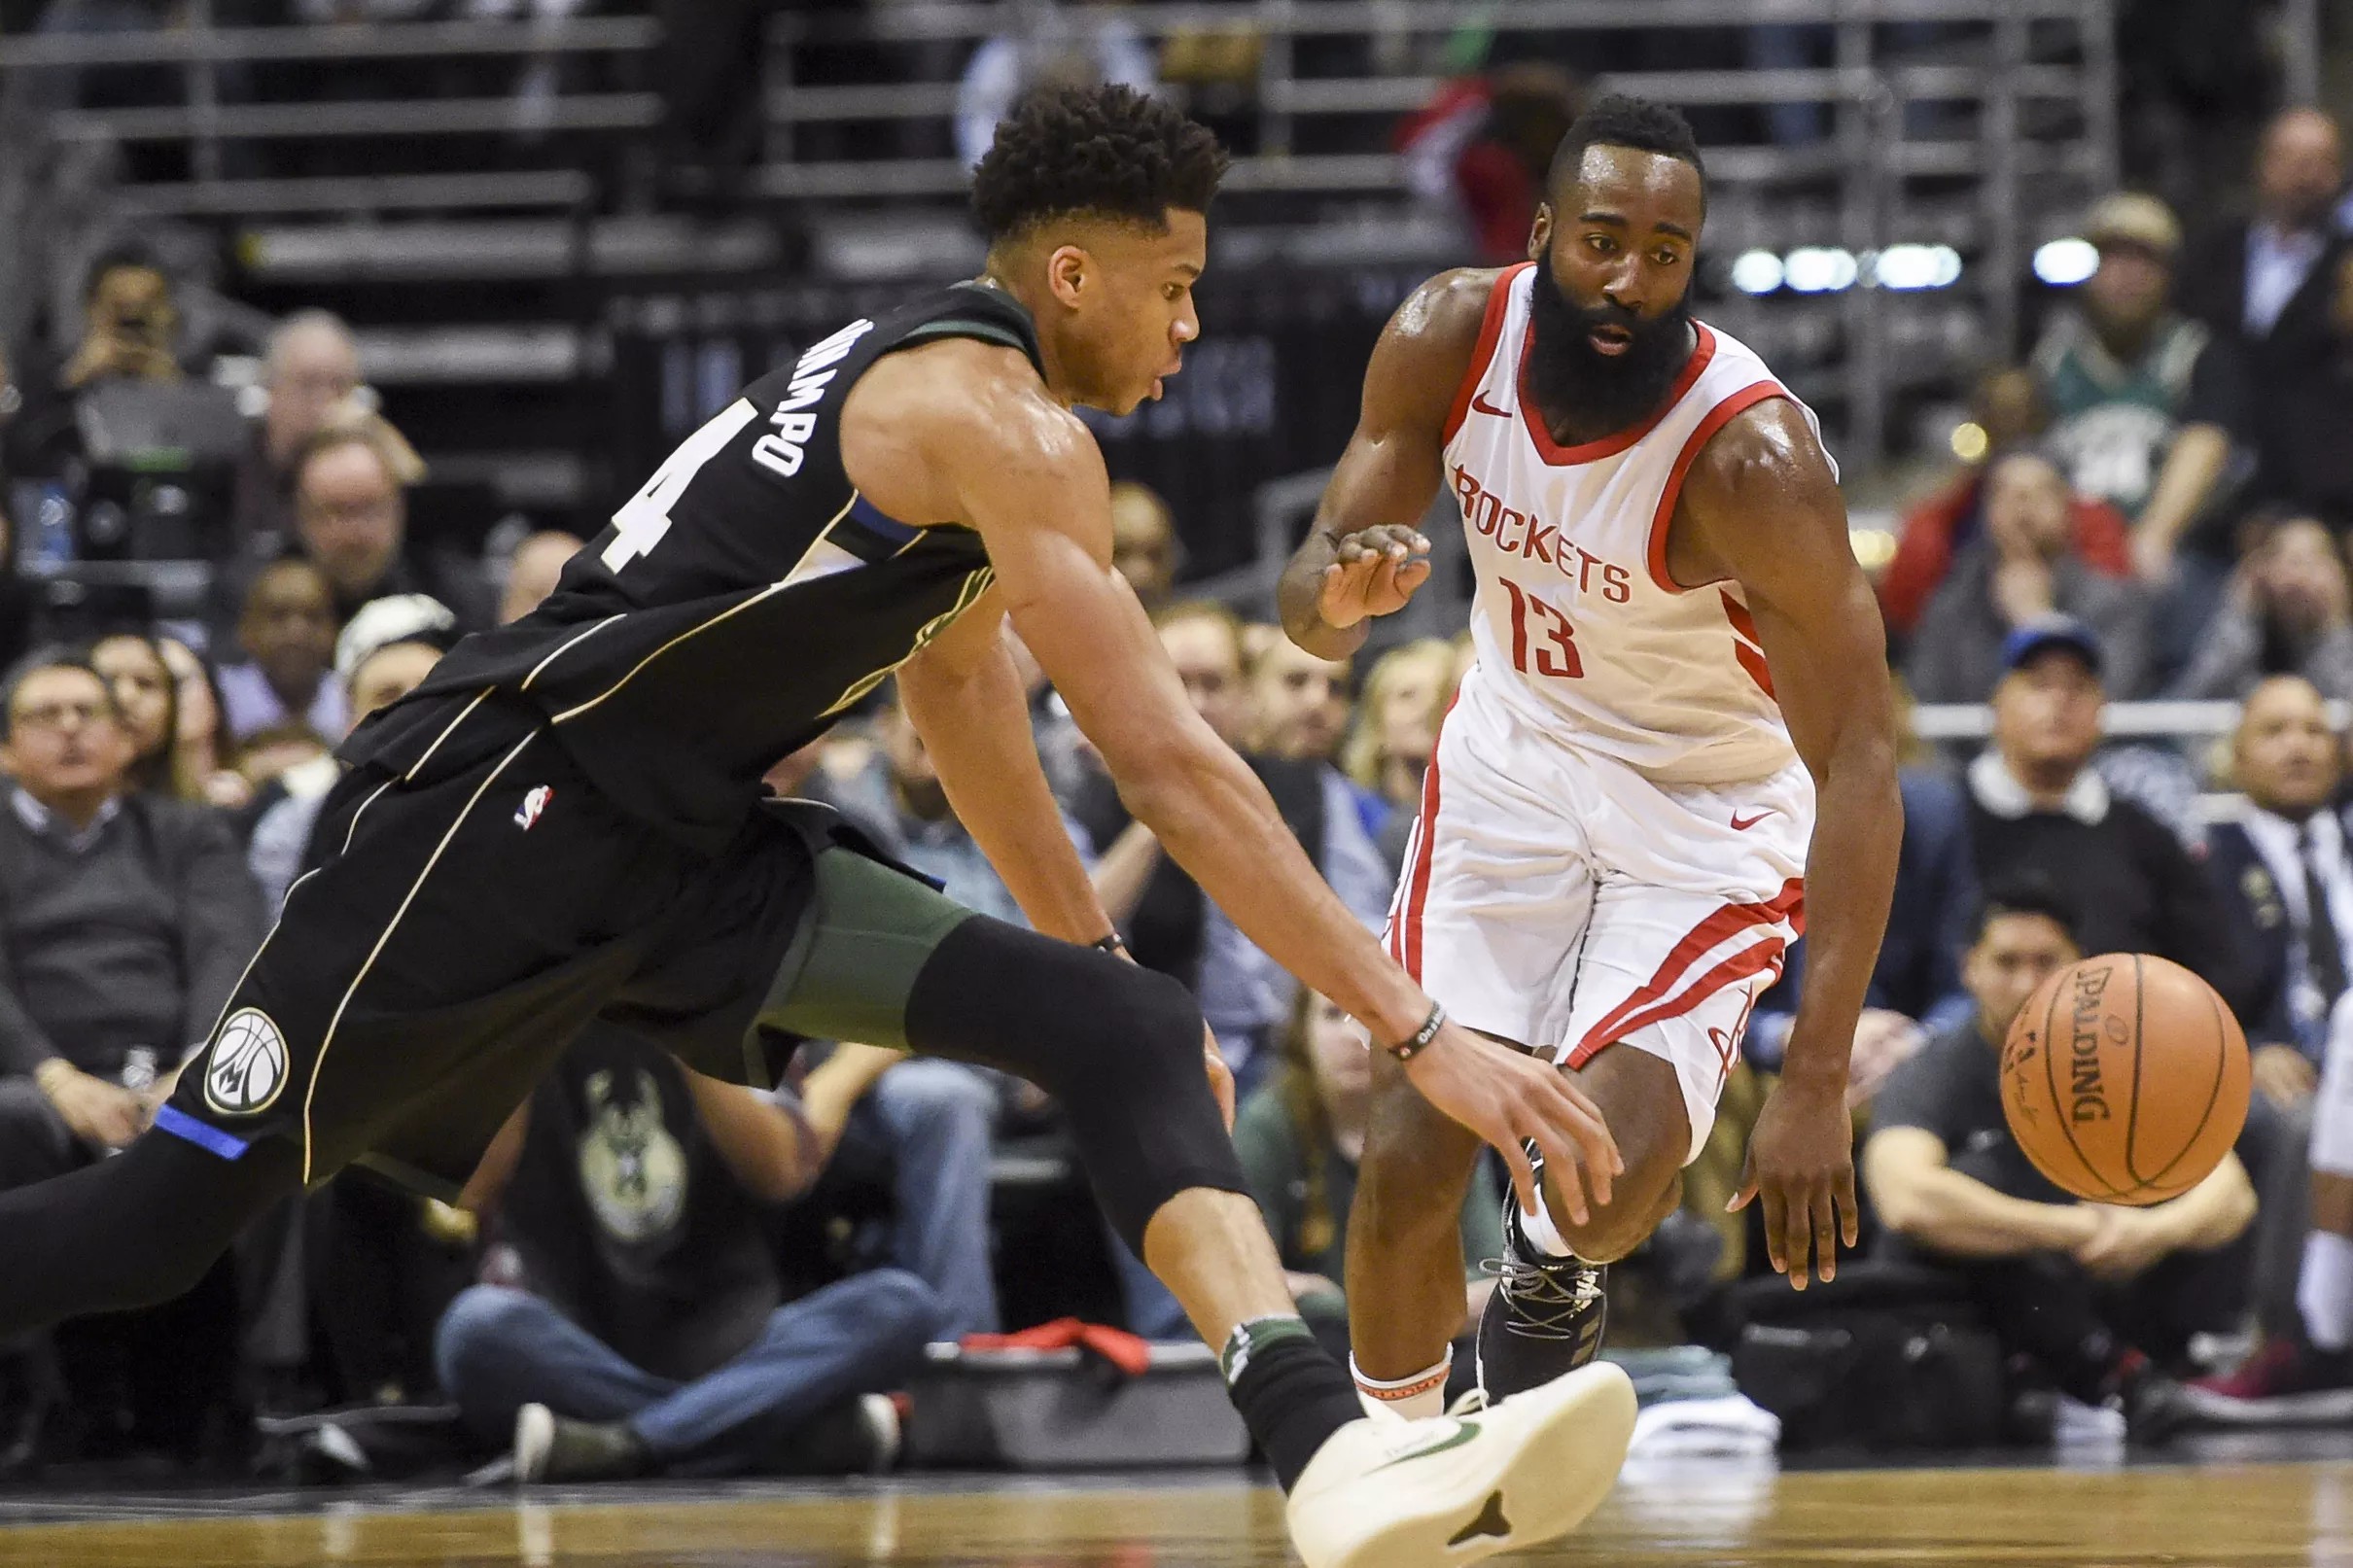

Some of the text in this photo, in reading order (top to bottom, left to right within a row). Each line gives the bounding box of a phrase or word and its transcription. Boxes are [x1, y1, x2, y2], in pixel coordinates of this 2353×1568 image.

[600, 397, 758, 575] 4
[1451, 464, 1631, 604] ROCKETS
[1498, 576, 1585, 679] 13
[2071, 966, 2114, 1124] SPALDING
